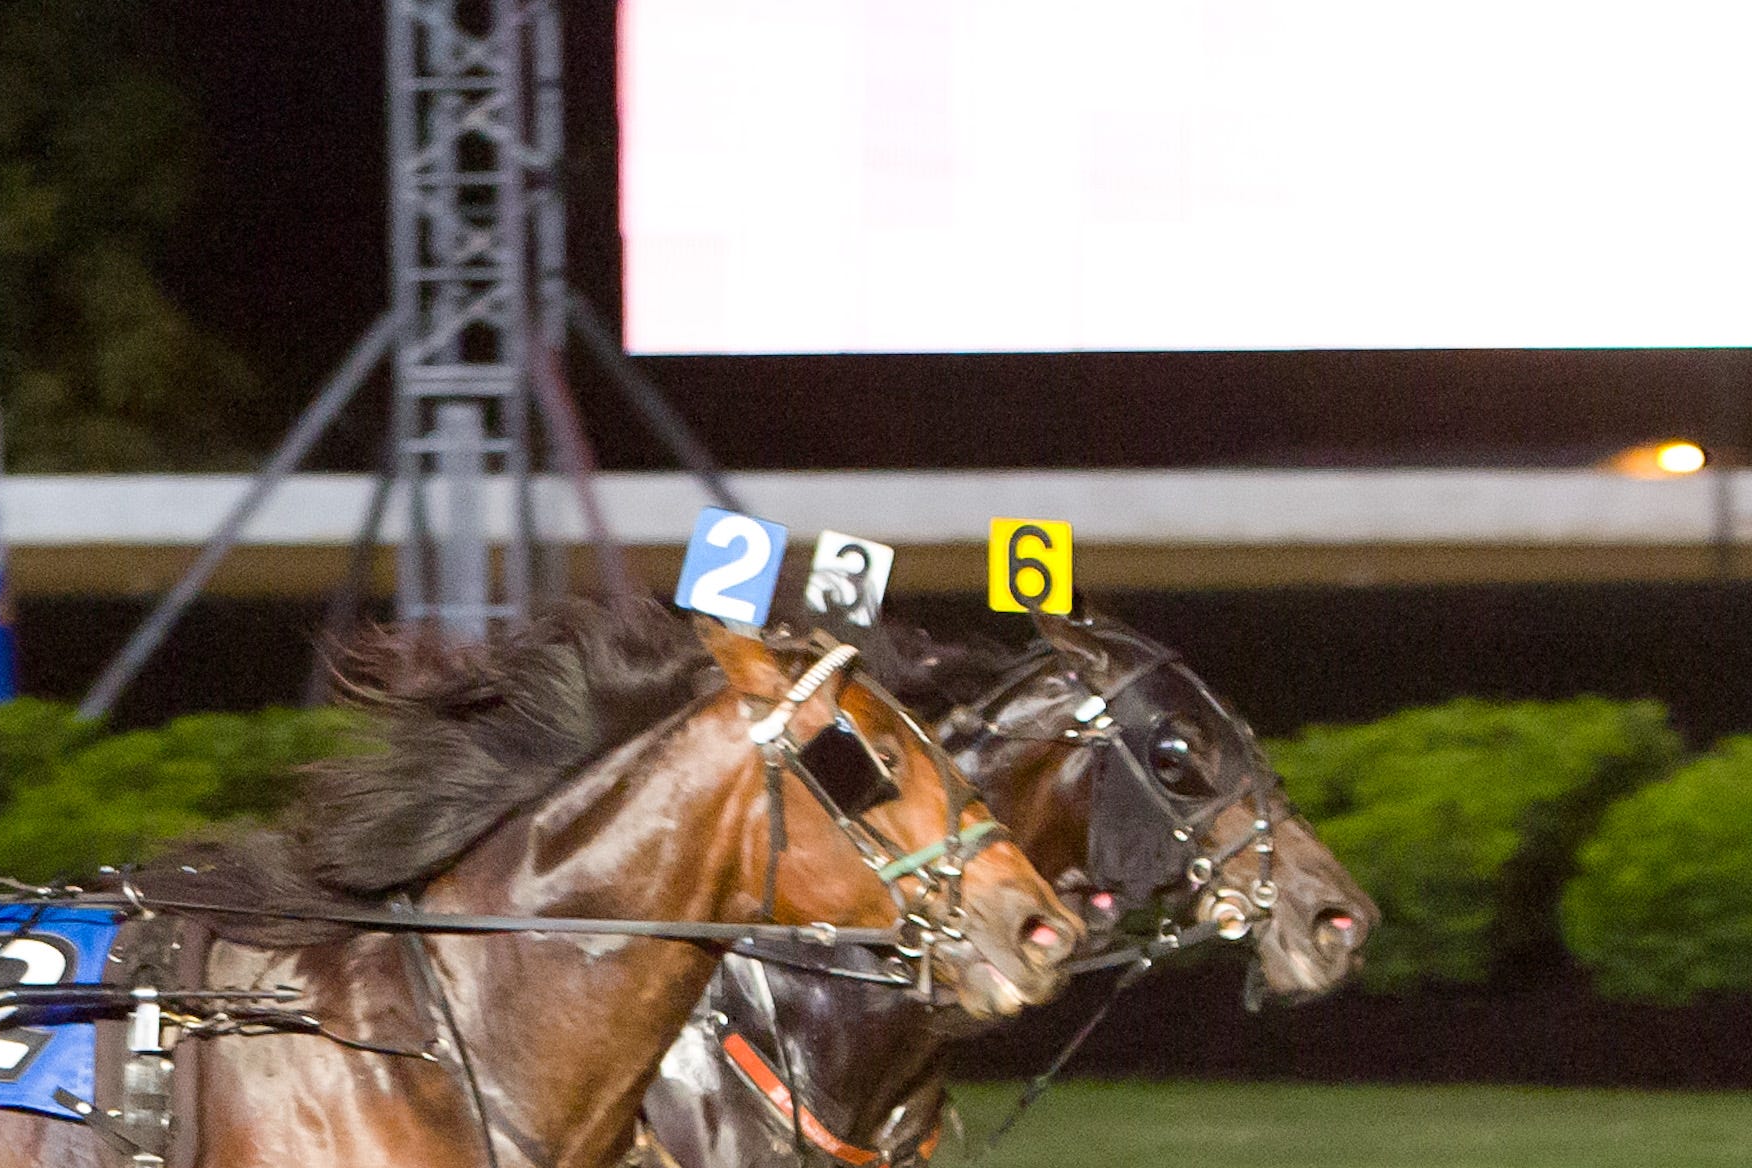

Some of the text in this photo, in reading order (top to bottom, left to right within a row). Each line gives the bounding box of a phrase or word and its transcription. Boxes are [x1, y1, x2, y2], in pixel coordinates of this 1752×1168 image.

[689, 515, 772, 623] 2
[828, 543, 870, 611] 3
[1008, 524, 1052, 609] 6
